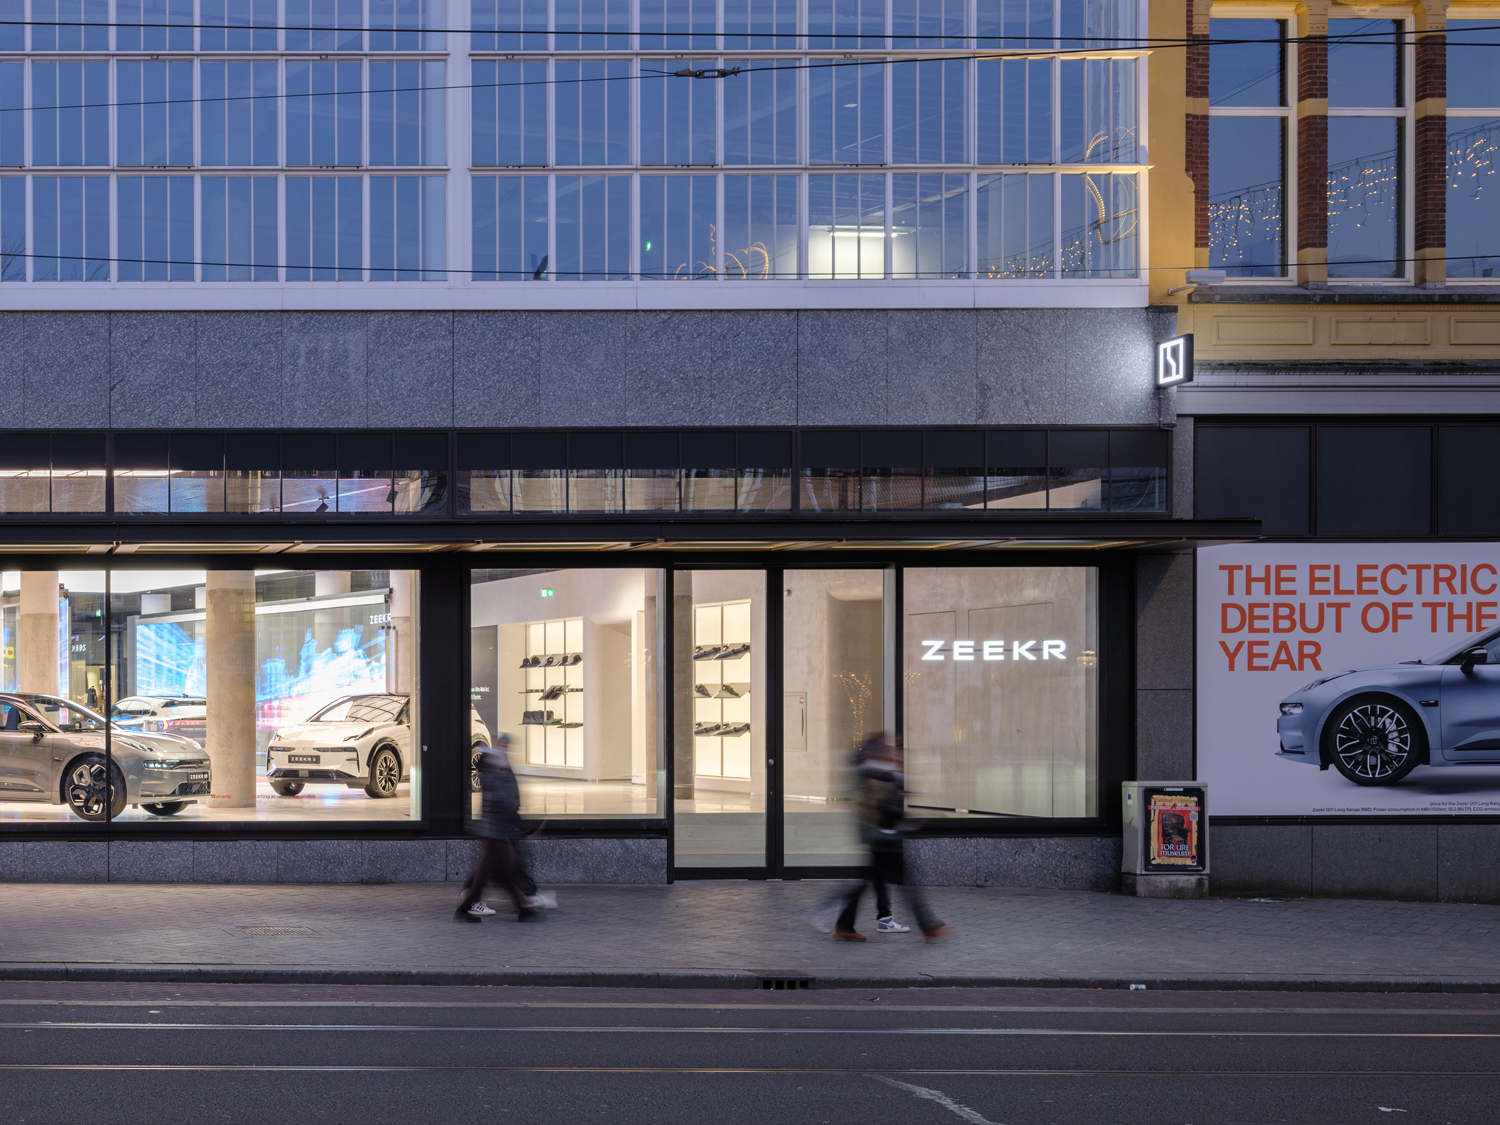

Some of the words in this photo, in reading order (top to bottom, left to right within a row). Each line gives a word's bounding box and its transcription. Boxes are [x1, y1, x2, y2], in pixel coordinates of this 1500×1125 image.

[1218, 564, 1296, 596] THE
[1308, 563, 1498, 596] ELECTRIC
[1220, 602, 1350, 634] DEBUT
[1360, 601, 1414, 634] OF
[1421, 600, 1498, 633] THE
[921, 639, 1067, 661] ZEEKR
[1218, 640, 1322, 672] YEAR
